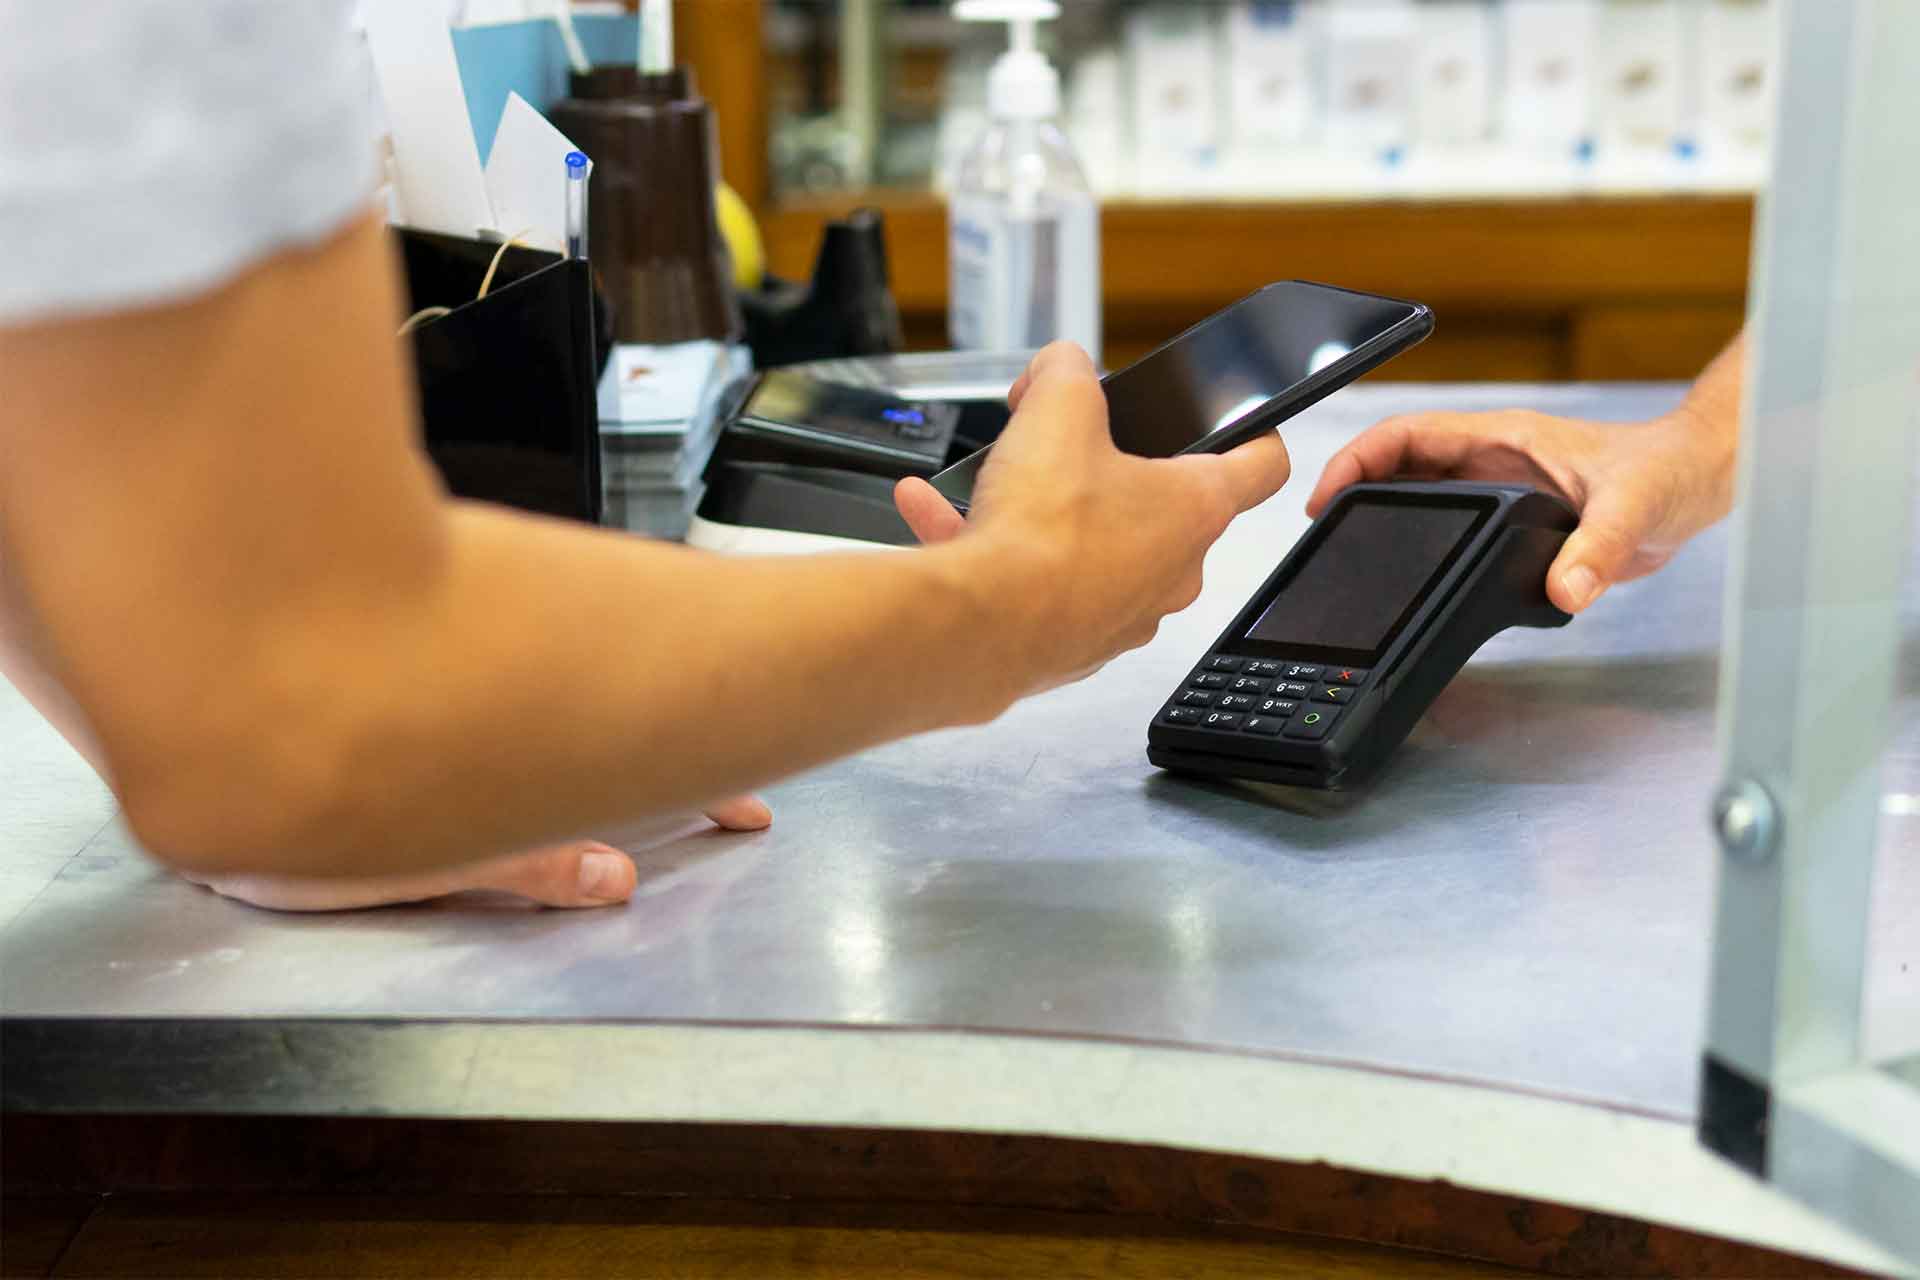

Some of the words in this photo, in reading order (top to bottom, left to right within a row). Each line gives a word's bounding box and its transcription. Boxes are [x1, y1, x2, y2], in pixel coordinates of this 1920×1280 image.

[1249, 662, 1260, 671] 2
[1289, 666, 1300, 675] 3
[1196, 674, 1206, 683] 4
[1235, 678, 1247, 687] 5
[1276, 683, 1287, 692] 6
[1183, 691, 1194, 700] 7
[1222, 696, 1233, 705] 8
[1263, 700, 1274, 709] 9
[1208, 713, 1218, 722] 0
